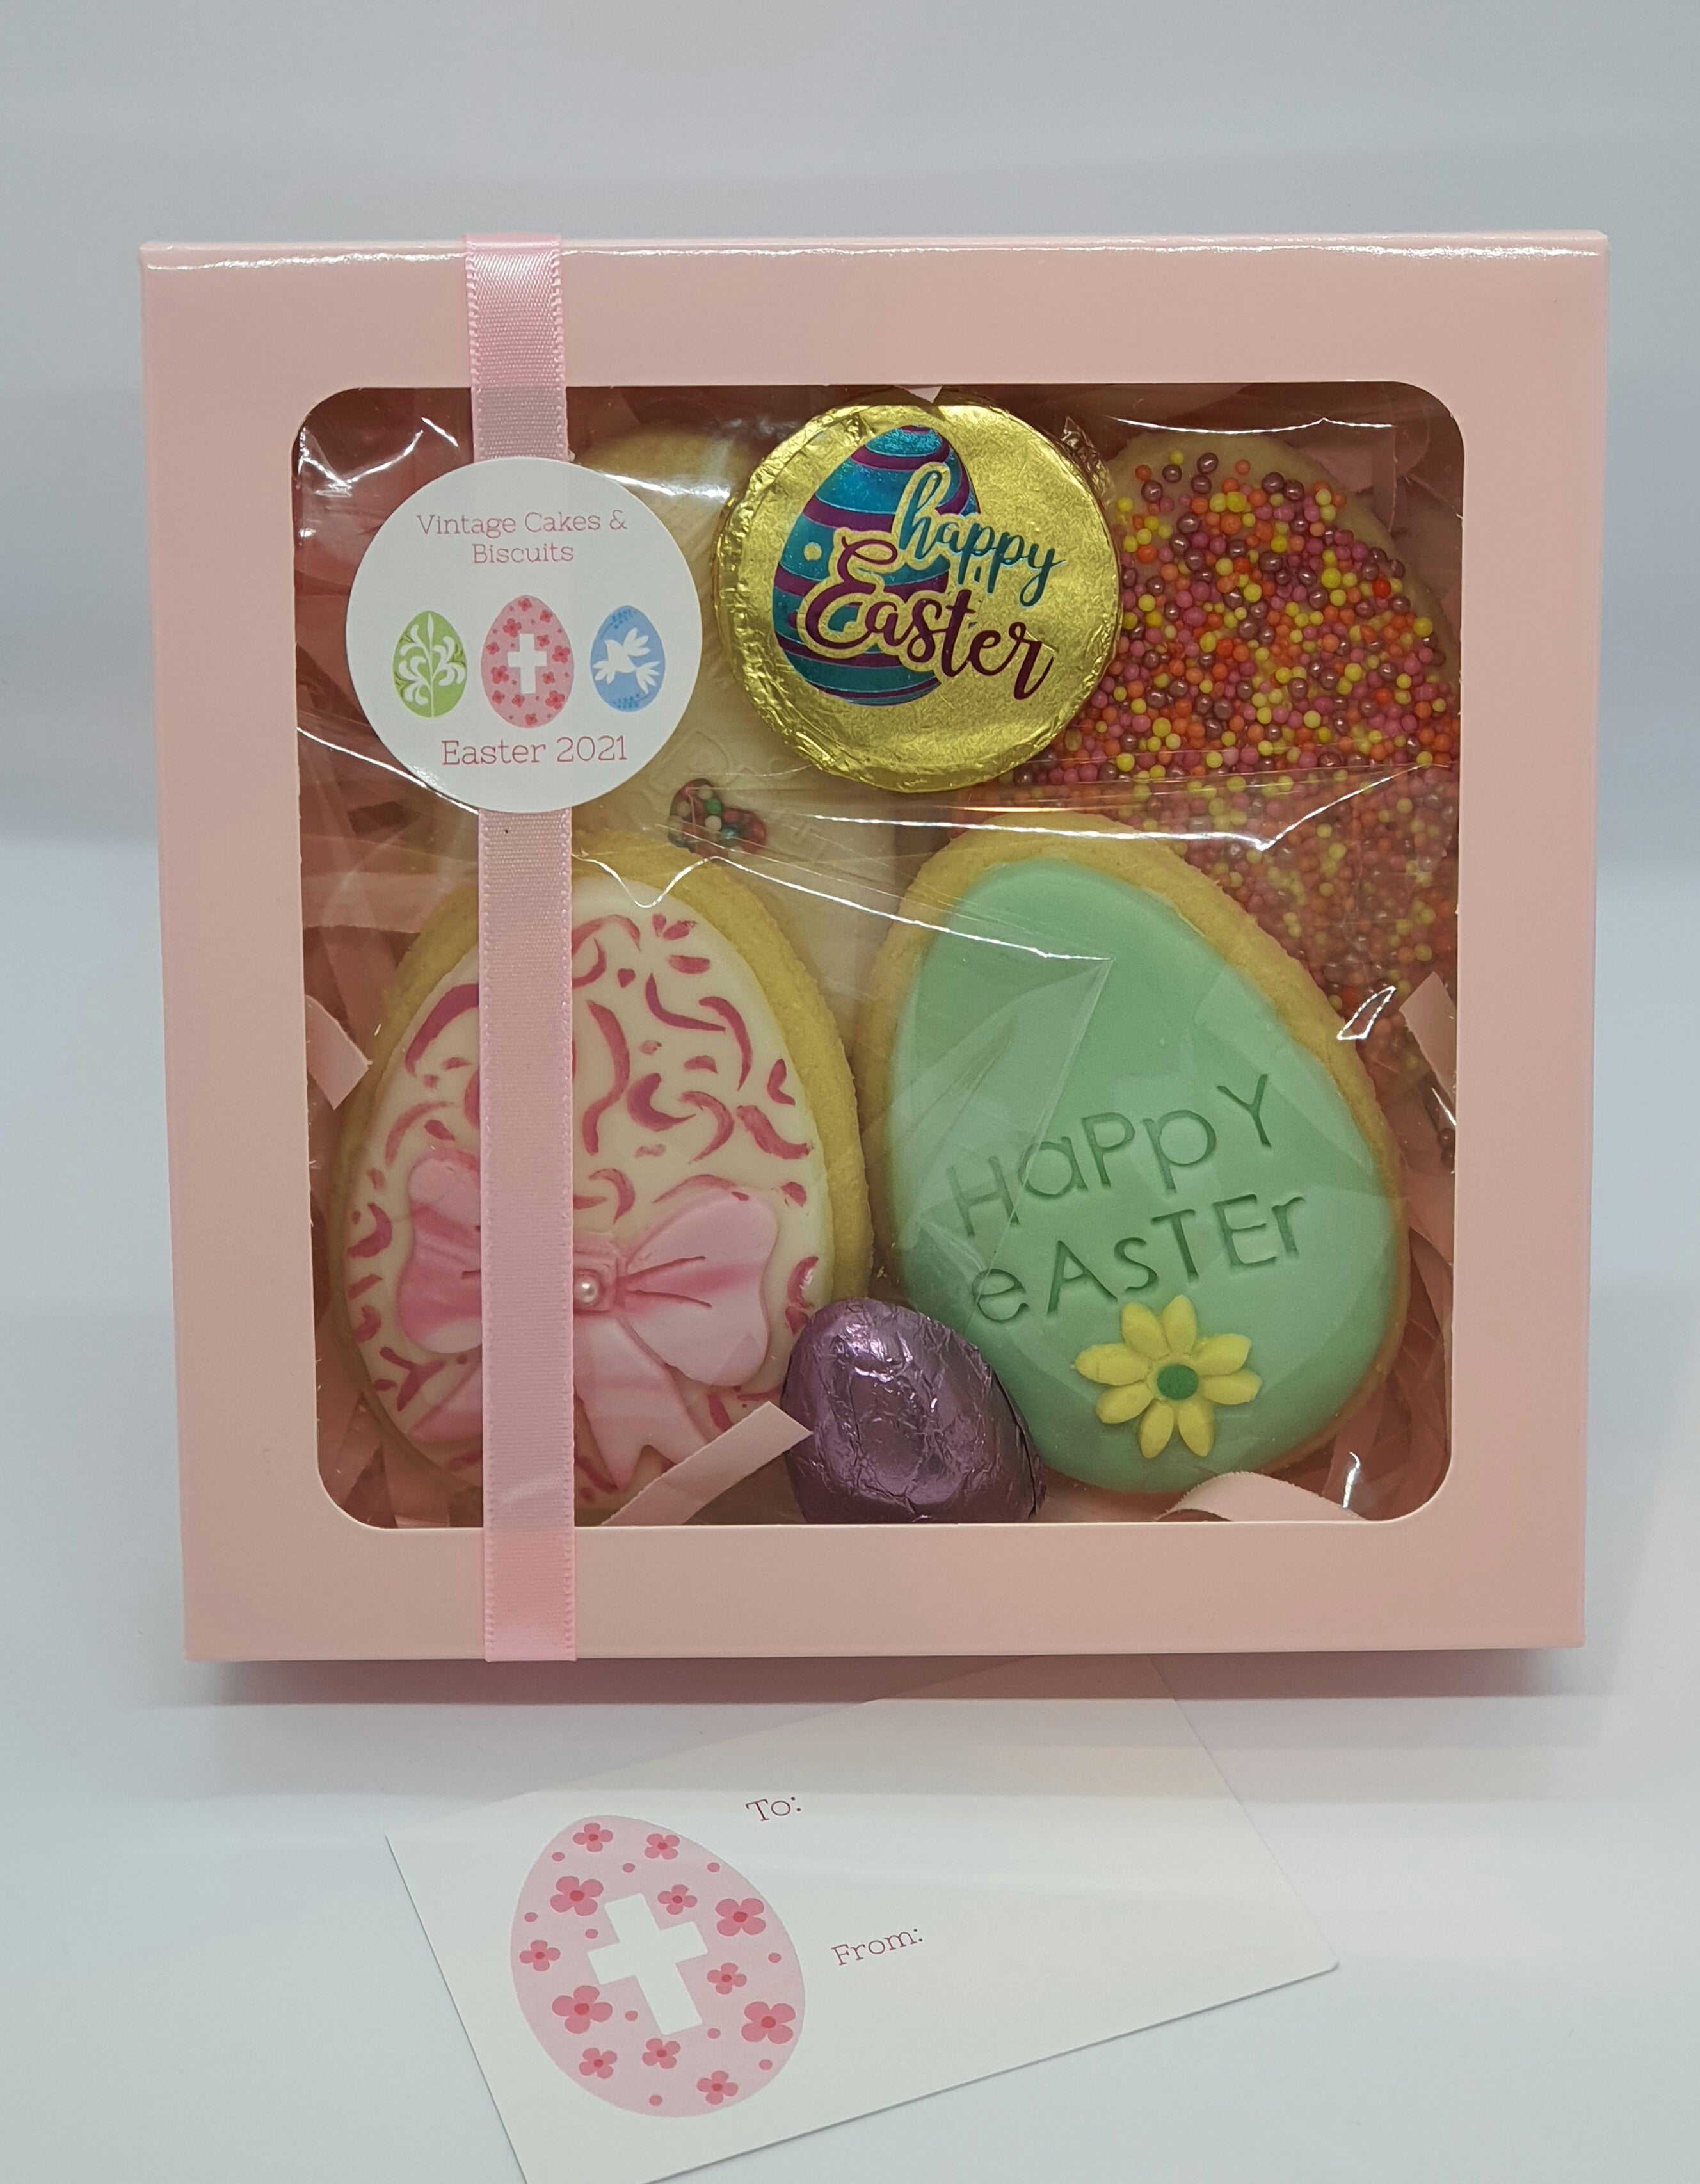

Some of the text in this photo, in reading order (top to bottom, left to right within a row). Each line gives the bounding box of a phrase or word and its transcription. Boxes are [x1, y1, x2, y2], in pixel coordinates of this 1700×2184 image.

[415, 509, 628, 538] Vintage Cakes &
[898, 470, 1066, 607] happy
[472, 542, 575, 564] Biscuits
[805, 535, 1055, 700] Easter
[440, 735, 628, 766] Easter 2021
[745, 1796, 801, 1822] To:
[831, 1928, 924, 1966] From:
